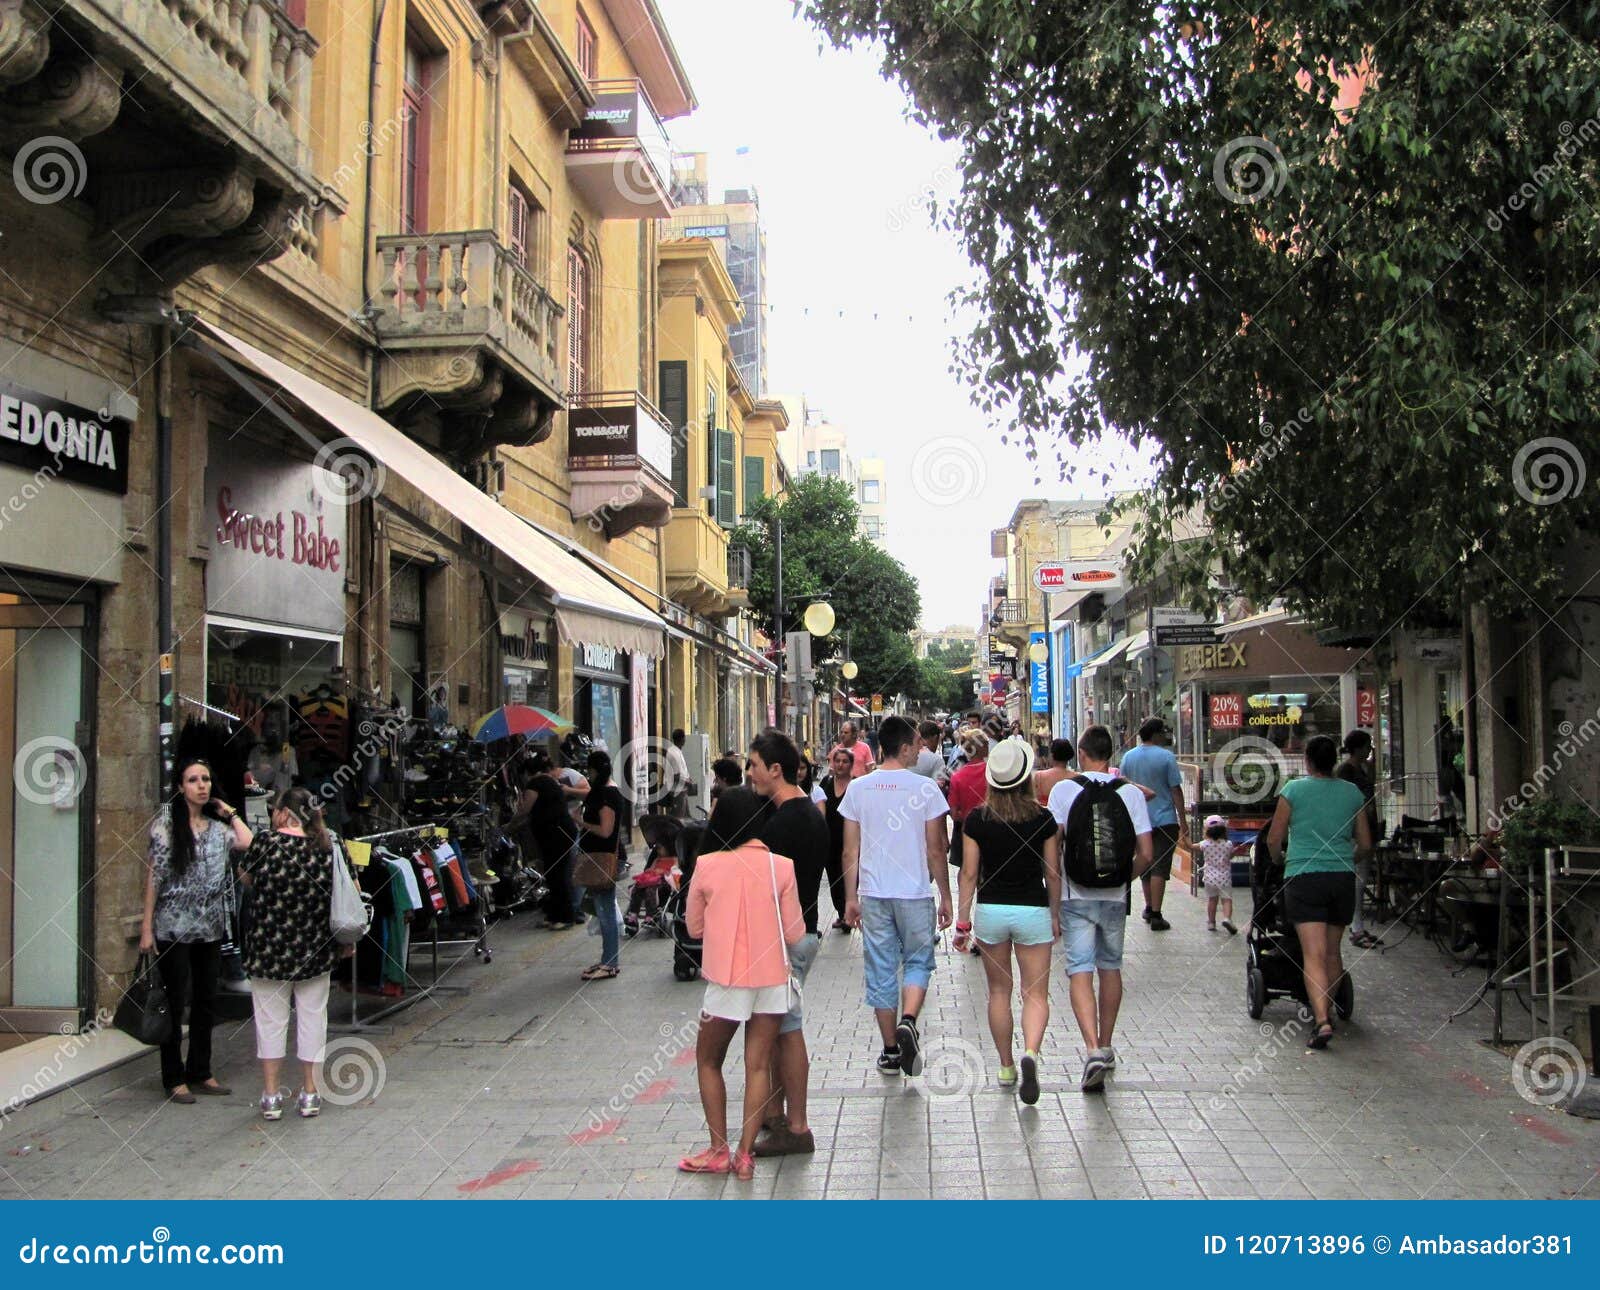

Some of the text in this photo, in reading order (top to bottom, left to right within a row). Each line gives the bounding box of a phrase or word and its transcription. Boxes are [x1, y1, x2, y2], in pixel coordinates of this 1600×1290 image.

[575, 425, 631, 437] TONI&GUY
[217, 486, 340, 573] Sweet Babe
[1037, 661, 1048, 693] MAV
[1213, 697, 1239, 712] 20%
[1213, 714, 1240, 726] SALE
[1248, 712, 1300, 726] collection
